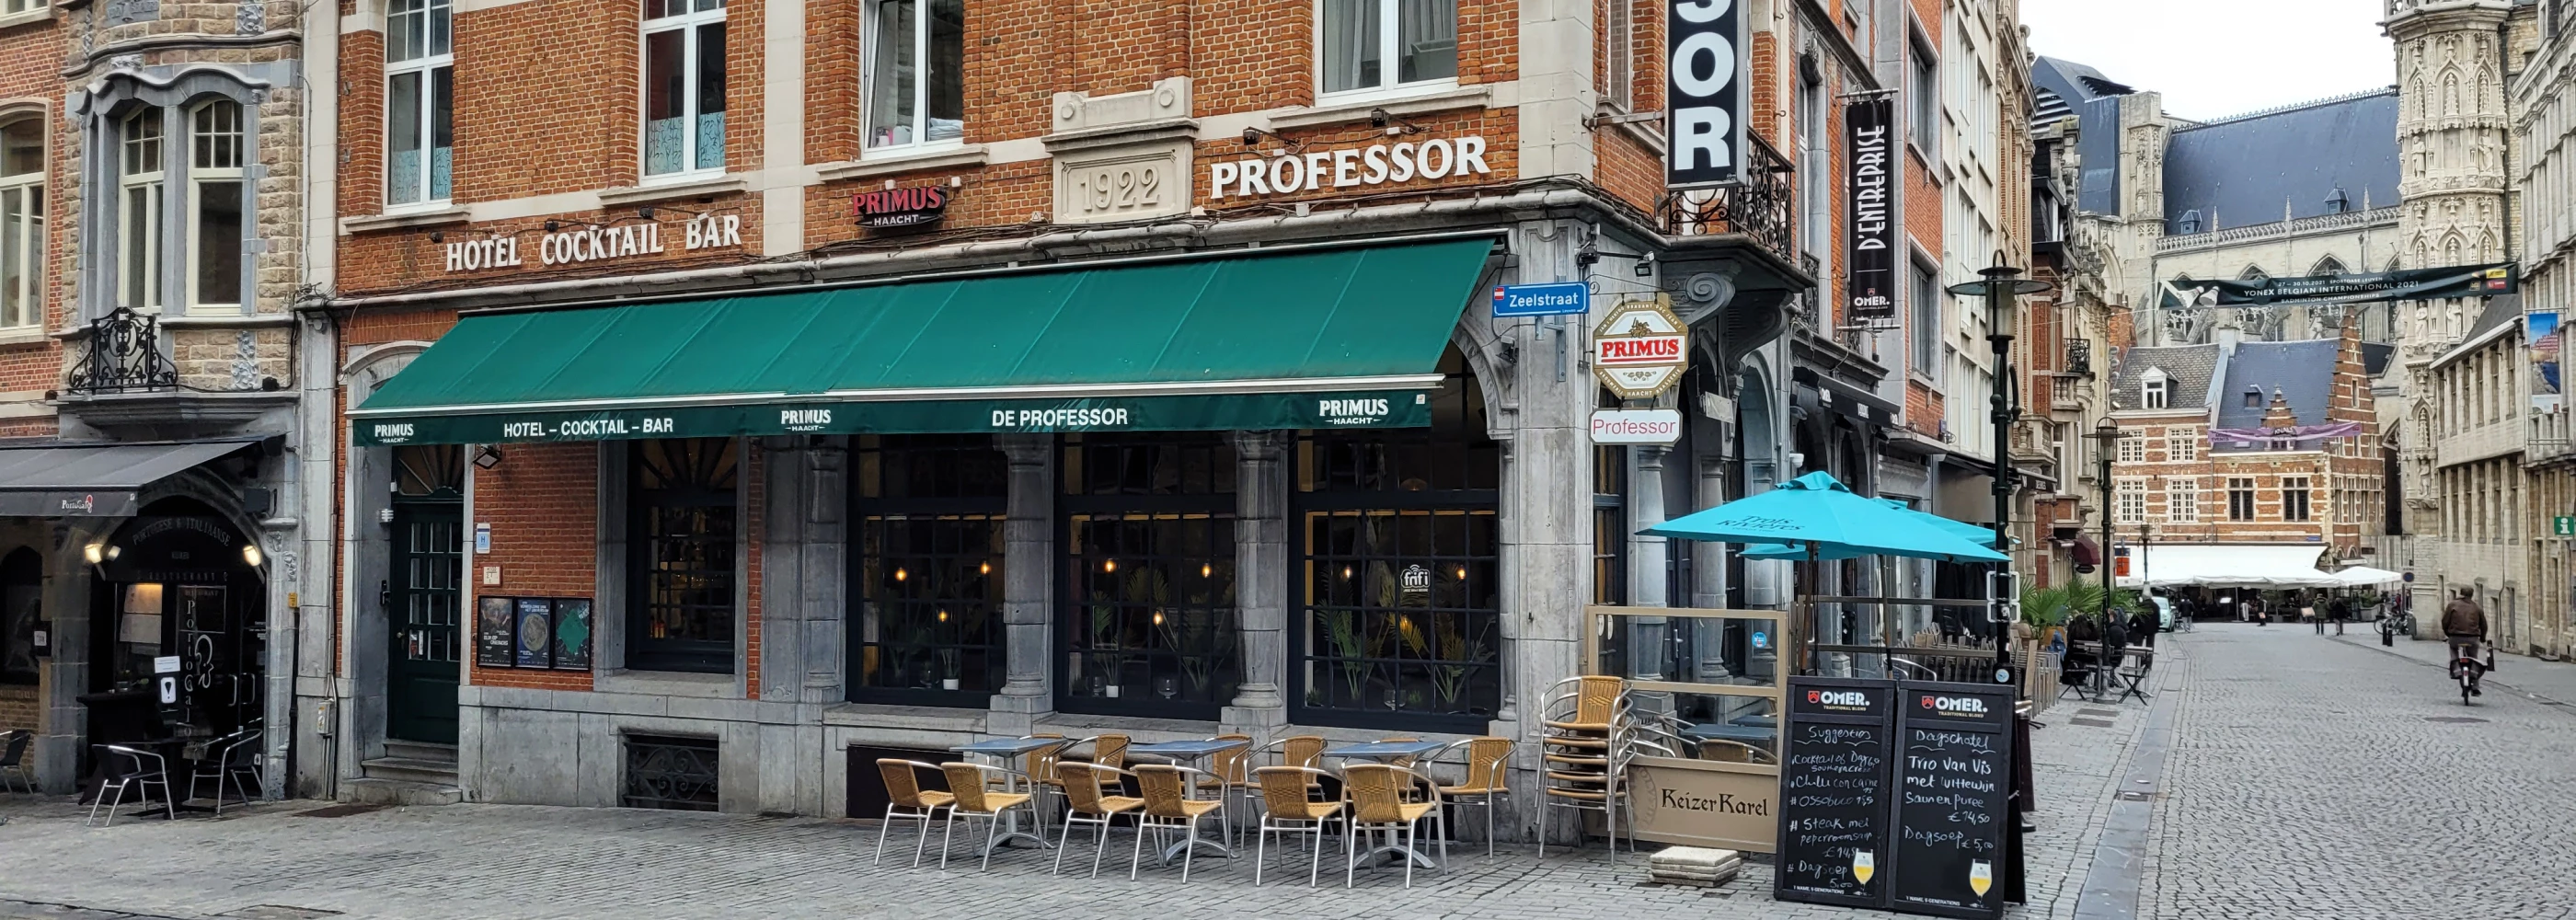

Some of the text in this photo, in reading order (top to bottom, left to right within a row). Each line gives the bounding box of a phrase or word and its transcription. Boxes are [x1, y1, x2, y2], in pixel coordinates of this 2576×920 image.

[1210, 135, 1491, 199] PROFESSOR
[1080, 165, 1161, 212] 1922
[1857, 125, 1885, 250] D'ENTREPRISE
[851, 186, 942, 216] PRIMUS
[874, 214, 919, 226] HAACHT
[446, 214, 742, 271] HOTEL COCKTAIL BAR
[2244, 288, 2274, 296] YONEX
[2319, 282, 2393, 293] INTERNATIONAL
[2397, 281, 2419, 289] 2021
[2323, 293, 2380, 302] CHAMPIONSHIPS
[1509, 293, 1579, 308] Zeelstraat
[1601, 339, 1679, 358] PRIMUS
[781, 409, 831, 424] PRIMUS
[1319, 399, 1389, 416] PRIMUS
[992, 408, 1128, 427] DE PROFESSOR
[1334, 417, 1373, 425] HAACHT
[1593, 419, 1676, 435] Professor
[374, 423, 414, 437] PRIMUS
[504, 422, 546, 438] HOTEL
[561, 419, 628, 436] COCKTAIL
[643, 418, 673, 433] BAR
[186, 517, 231, 546] ITALIAANSE
[1908, 755, 1992, 775] Trio Van Vis
[1907, 774, 1936, 788] met
[1662, 788, 1717, 812] Keizer
[1719, 793, 1769, 817] Karel
[1803, 818, 1845, 830] Steak
[1904, 825, 1963, 849] Dagsoep
[1799, 860, 1847, 880] Dagsoep
